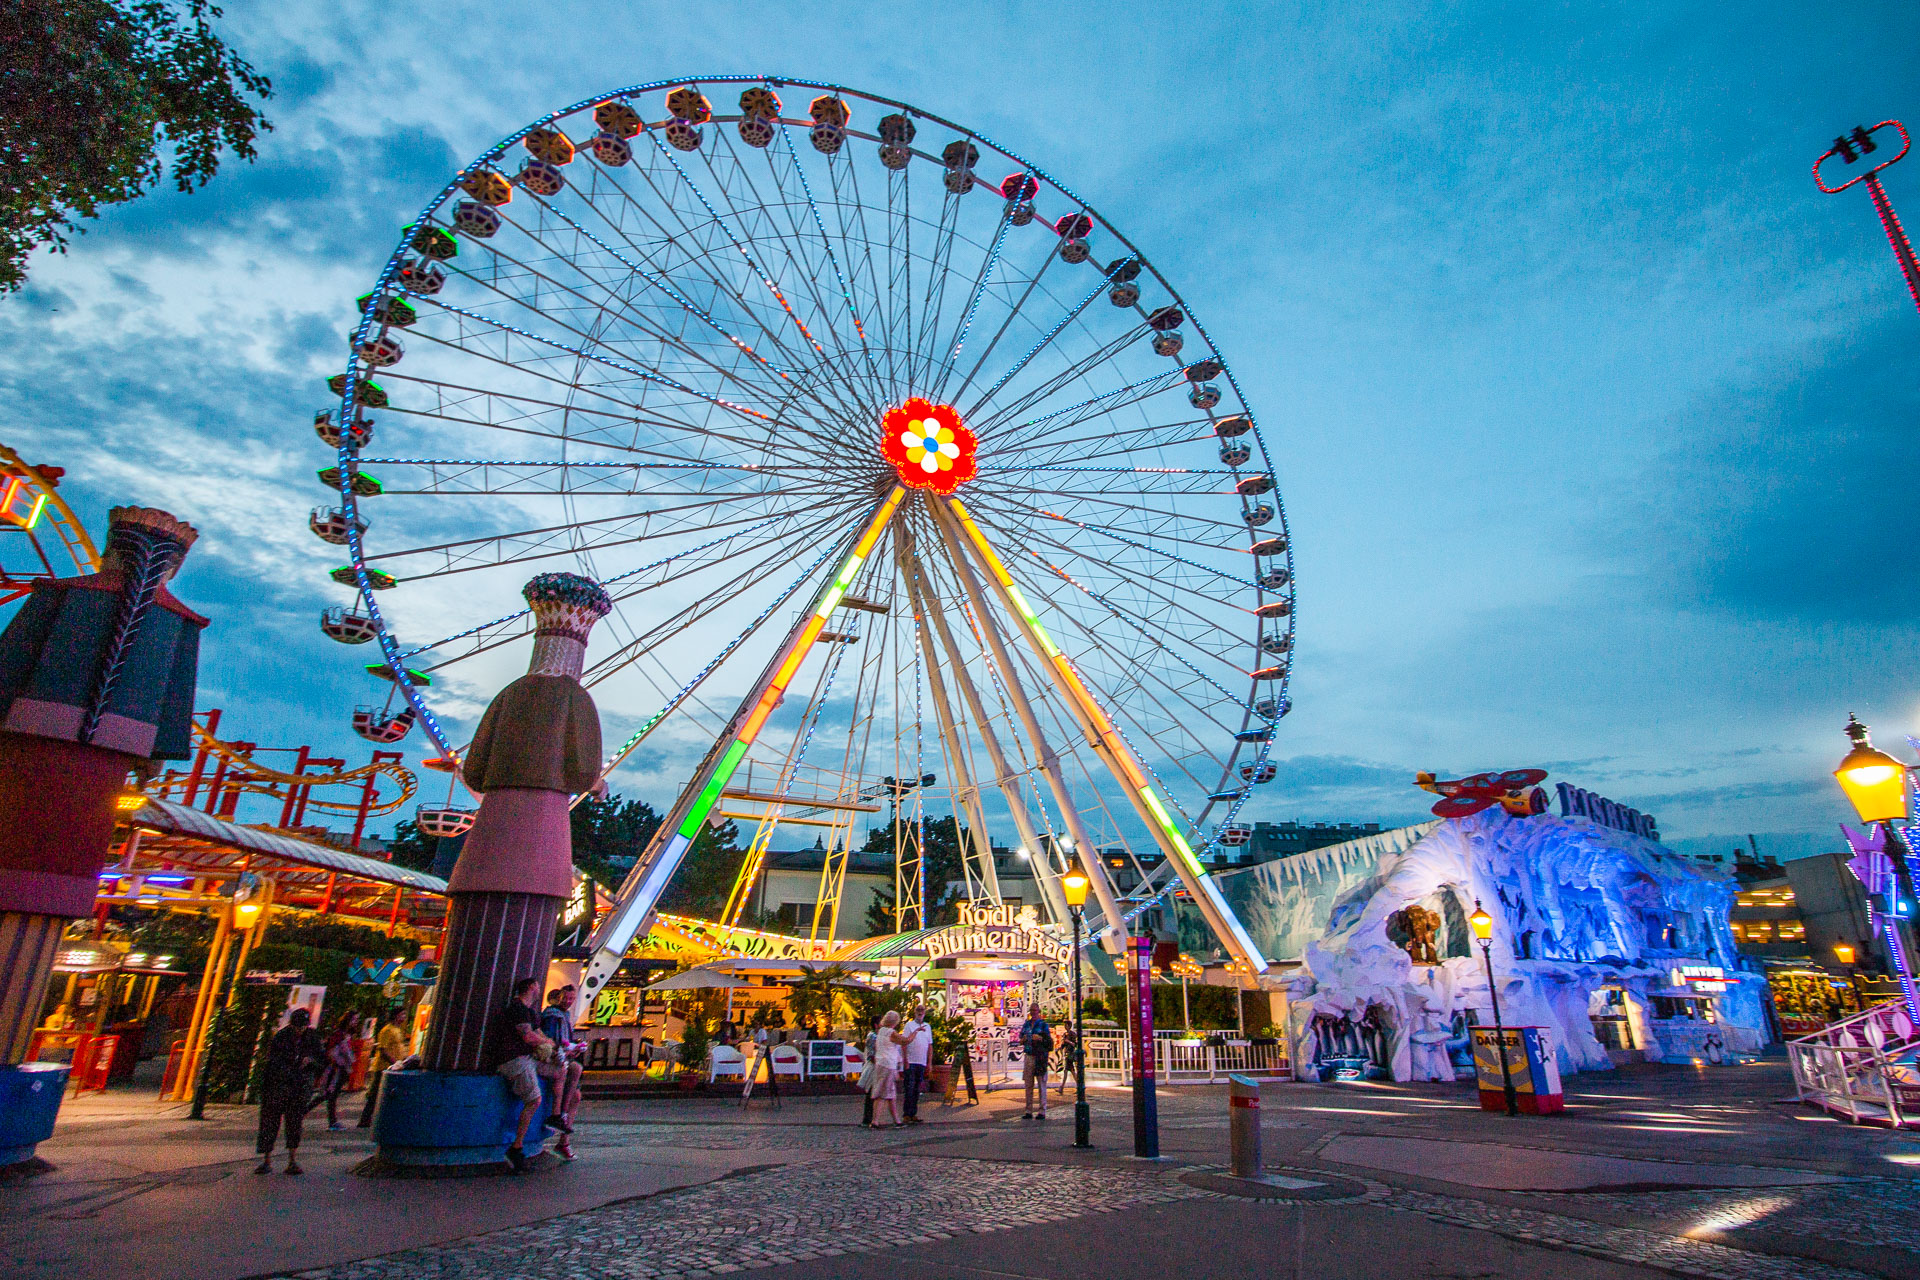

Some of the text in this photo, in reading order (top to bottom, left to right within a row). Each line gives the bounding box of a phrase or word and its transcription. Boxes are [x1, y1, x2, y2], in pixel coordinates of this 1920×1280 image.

[1555, 781, 1660, 842] EISBERG
[564, 898, 586, 925] BAR
[955, 902, 1014, 927] Koidl
[921, 928, 1075, 965] Blumen Rad
[1476, 1035, 1521, 1047] DANER
